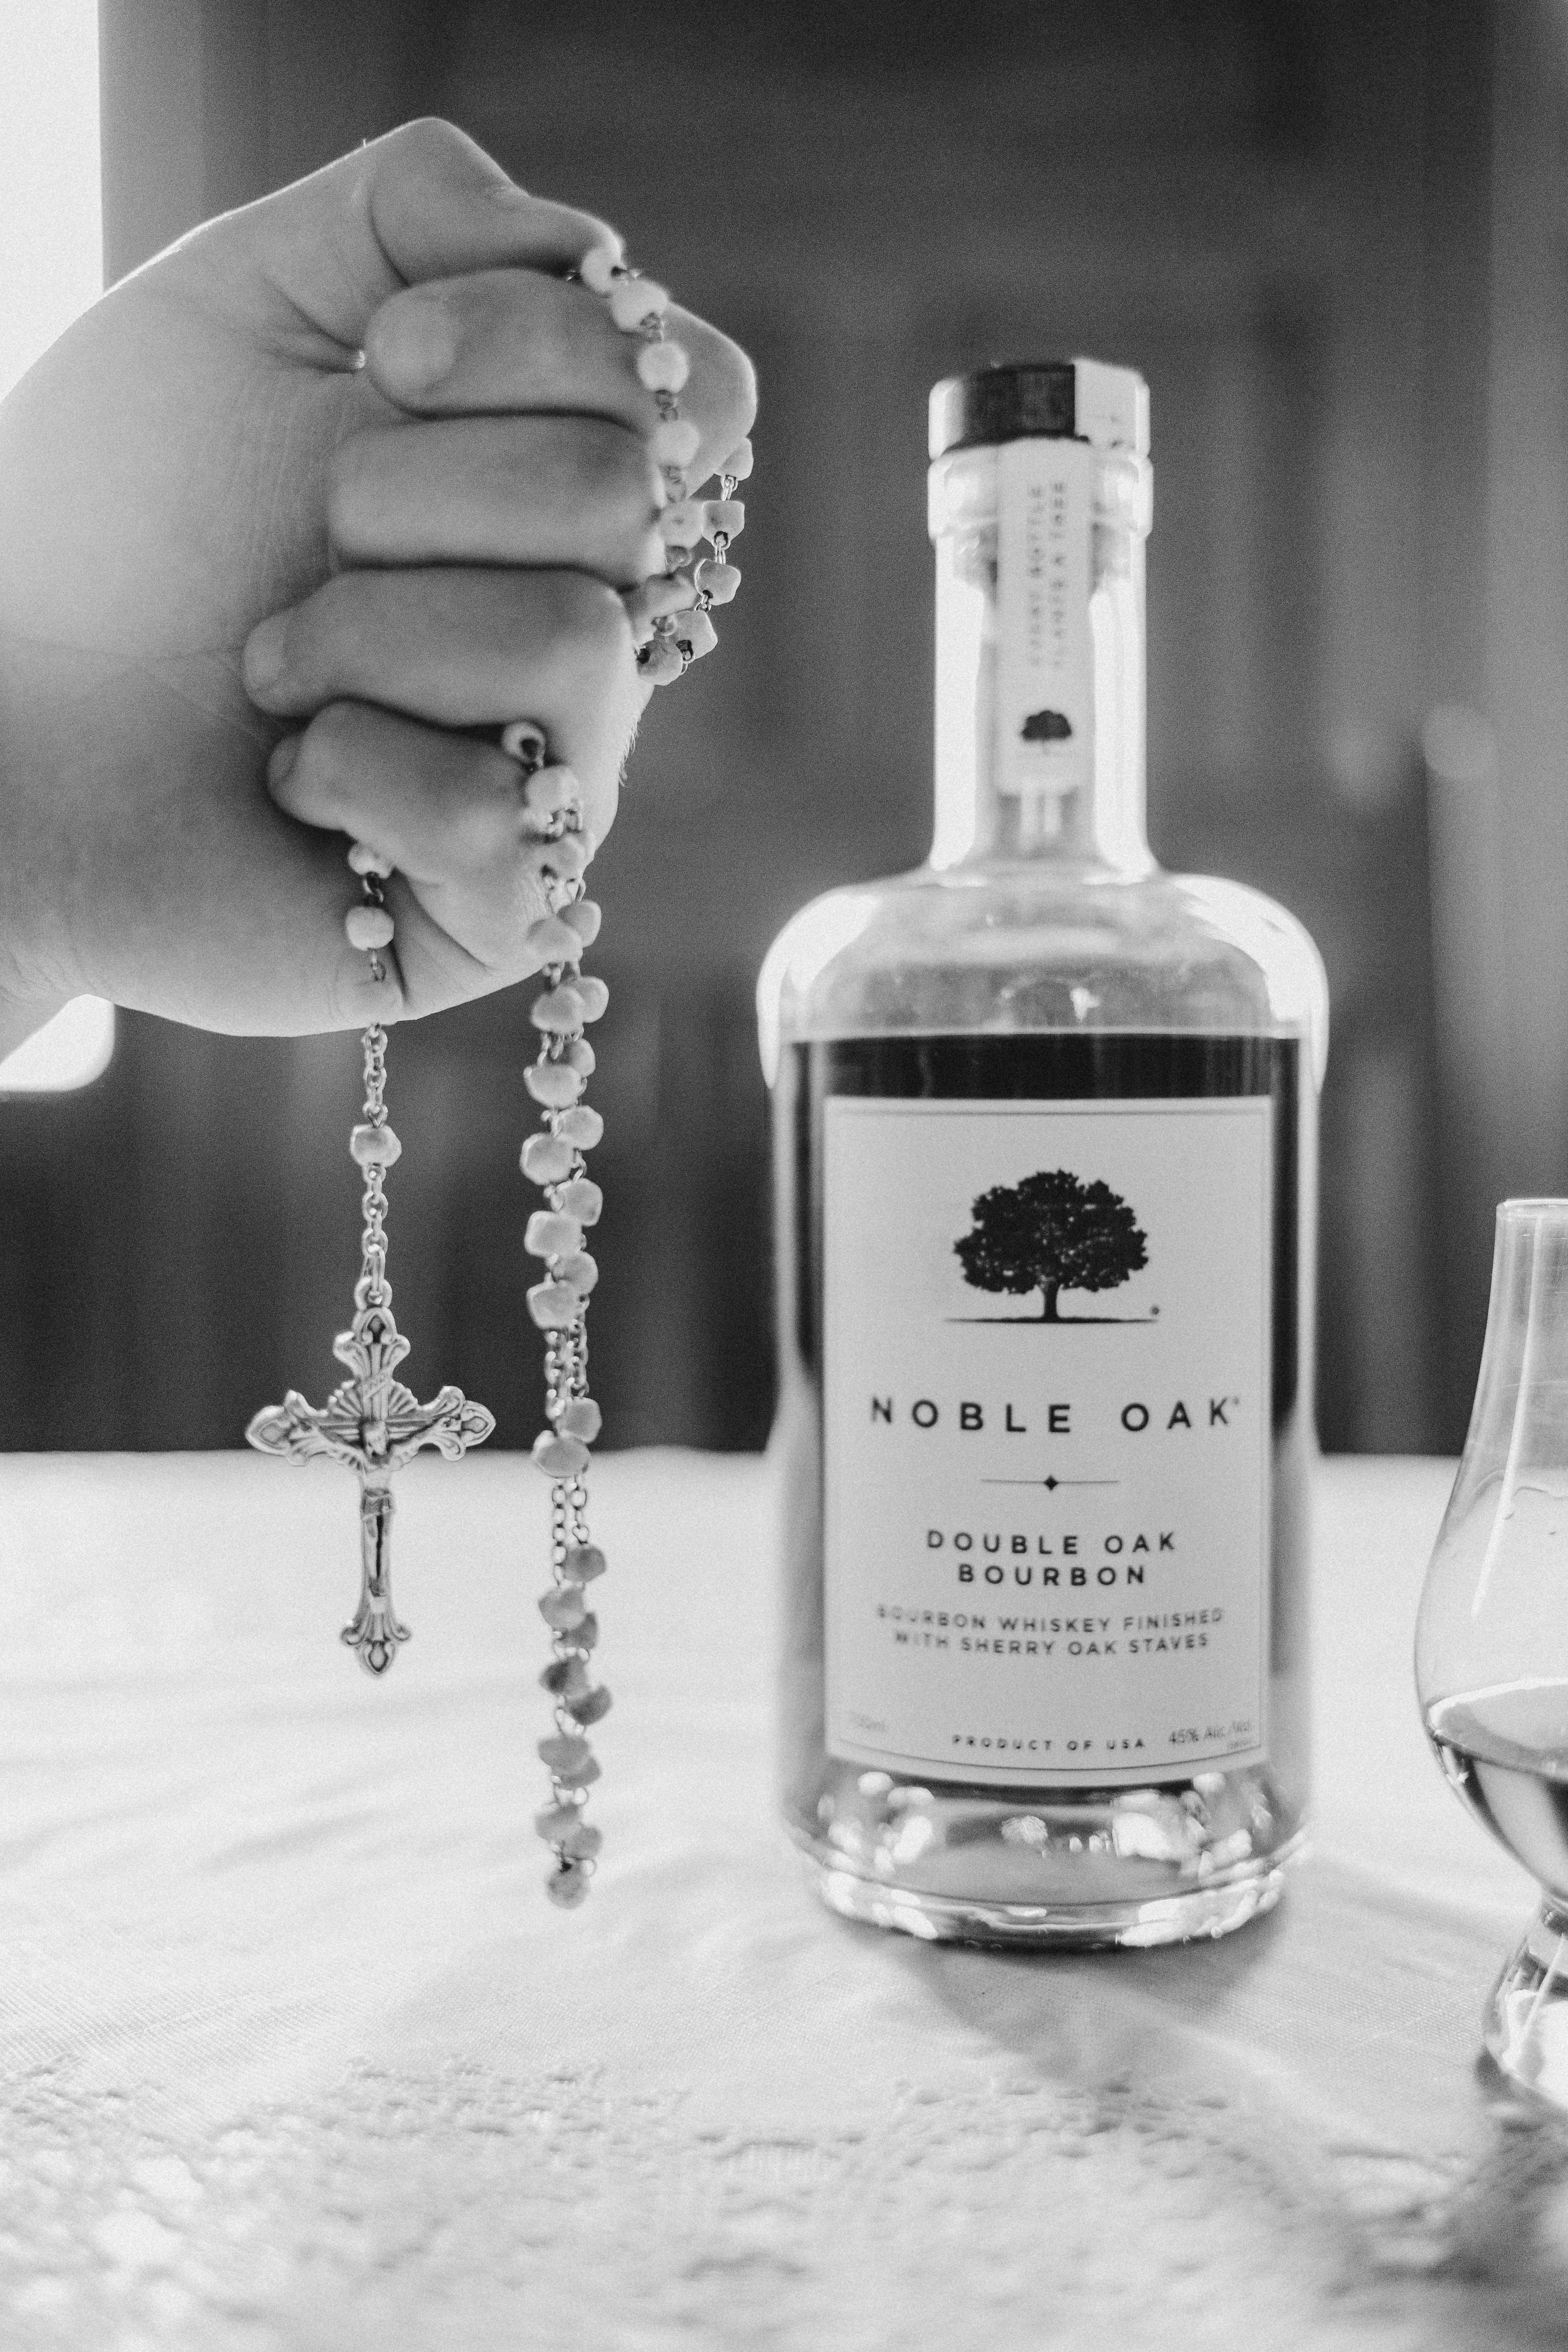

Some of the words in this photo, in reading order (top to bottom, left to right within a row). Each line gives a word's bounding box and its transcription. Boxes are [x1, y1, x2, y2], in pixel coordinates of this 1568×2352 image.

[870, 1396, 1071, 1434] NOBLE
[1120, 1396, 1228, 1433] OAK
[927, 1529, 1078, 1556] DOUBLE
[1104, 1531, 1174, 1555] OAK
[958, 1563, 1144, 1587] BOURBON
[878, 1605, 986, 1630] BOURBON
[999, 1616, 1110, 1634] WHISKEY
[1123, 1607, 1223, 1630] FINISHED
[894, 1631, 949, 1648] WITH
[961, 1637, 1054, 1655] SHERRY
[1067, 1640, 1117, 1656] OAK
[1129, 1633, 1208, 1654] STAVES
[952, 1735, 1053, 1751] PRODUCT
[1067, 1740, 1092, 1752] OF
[1107, 1738, 1145, 1751] USA
